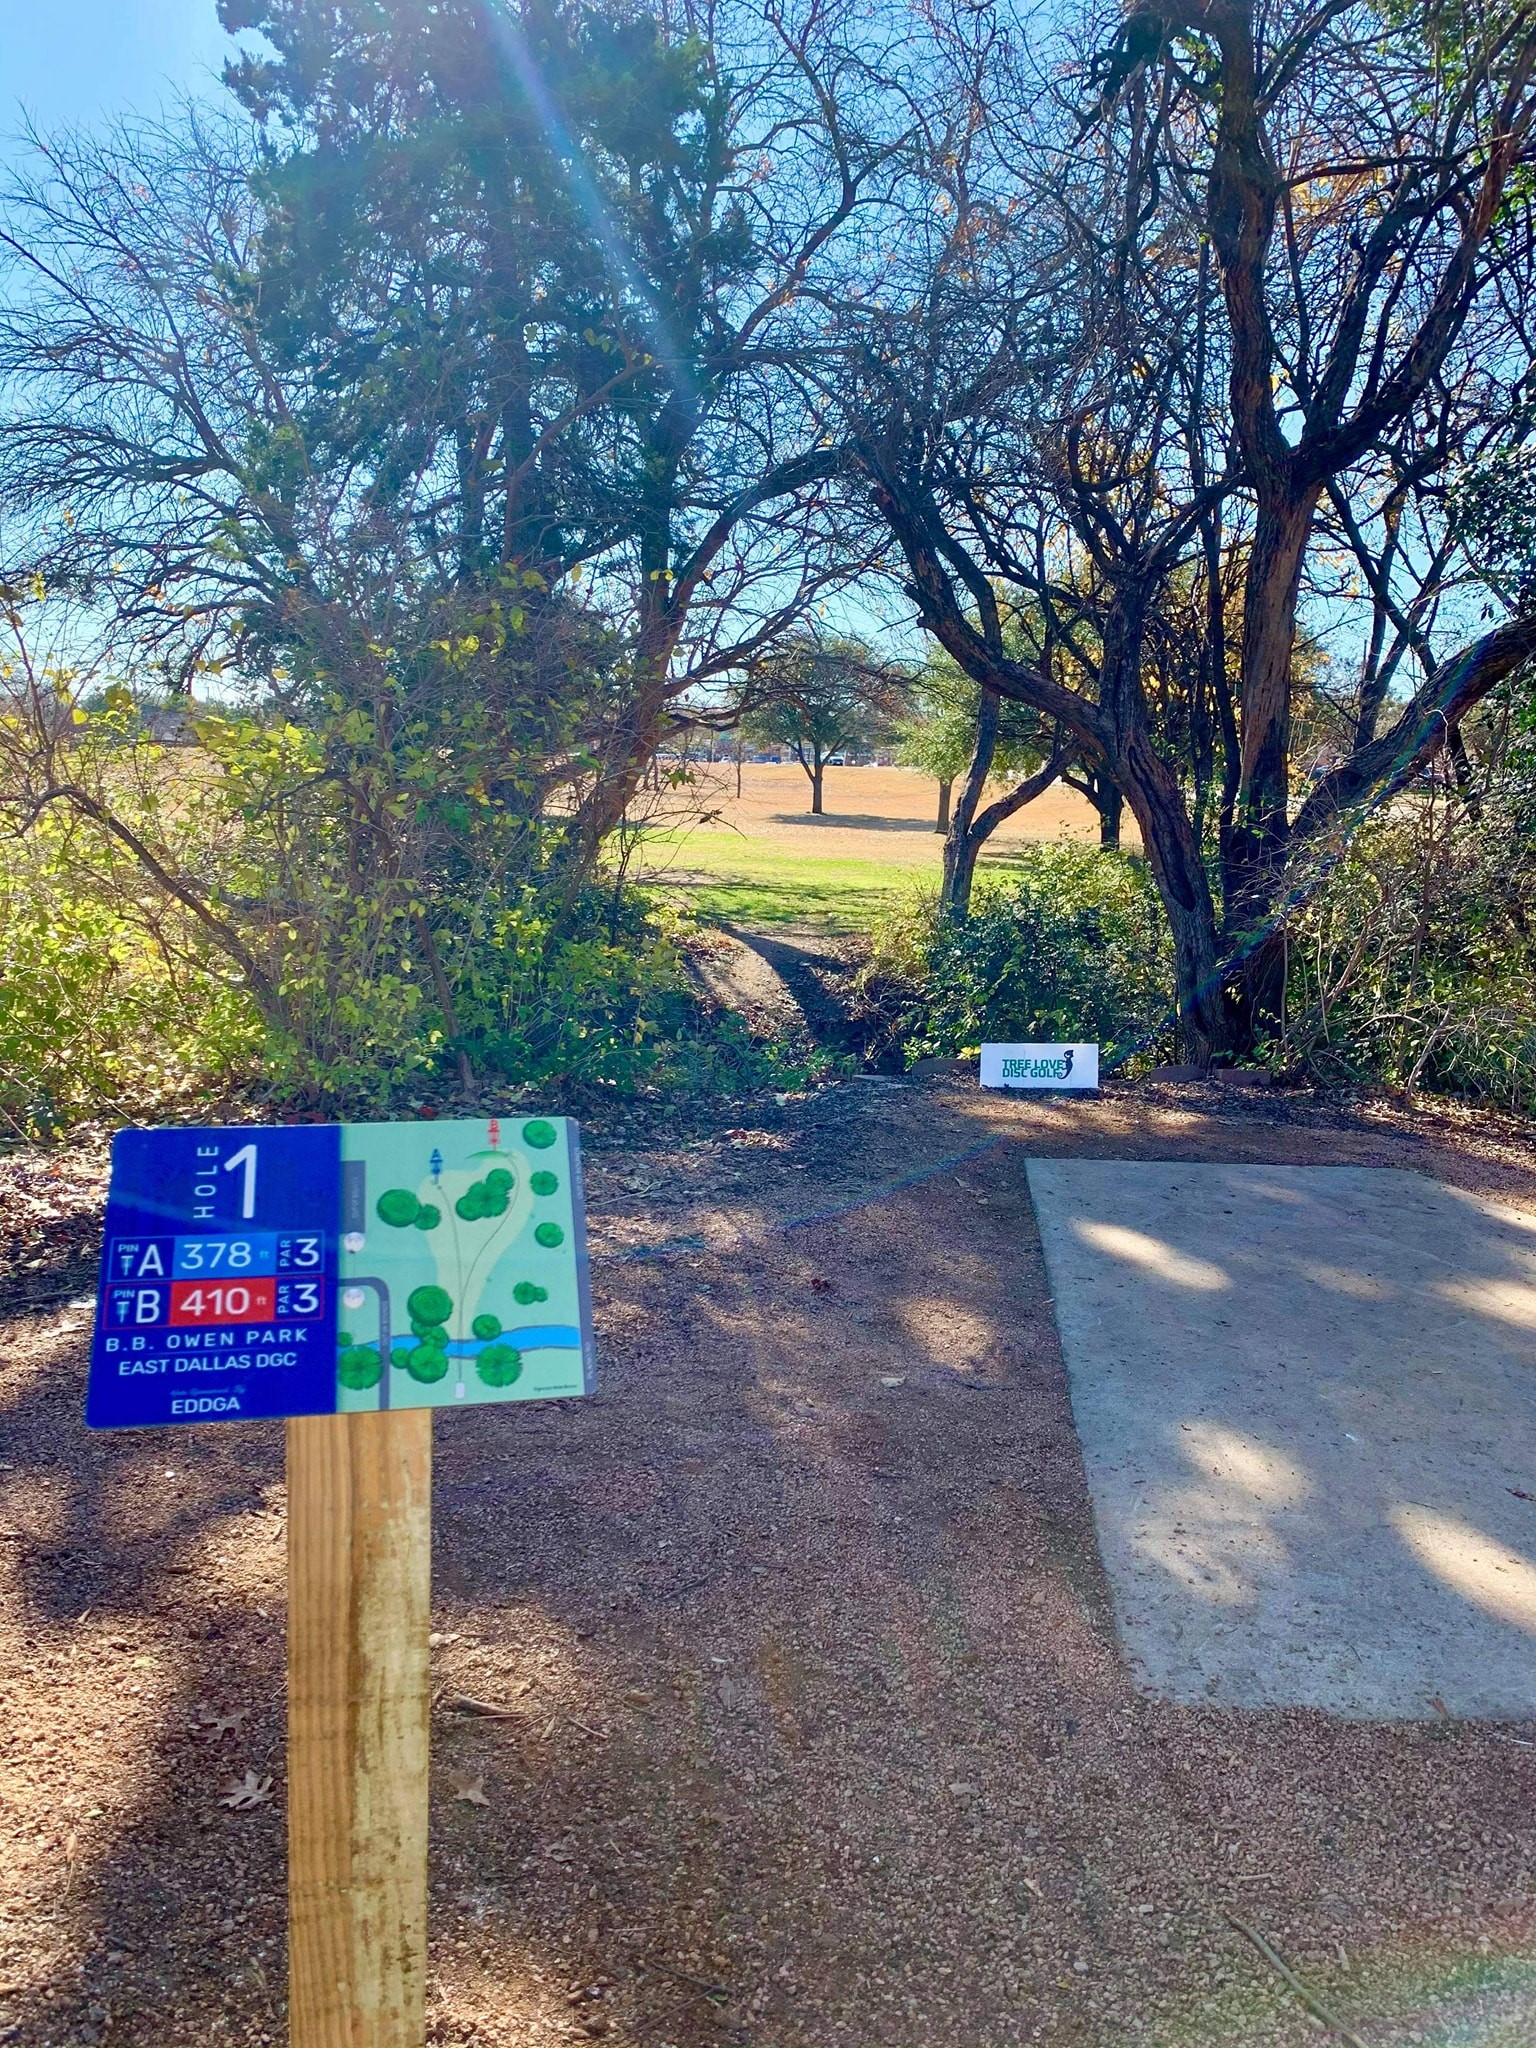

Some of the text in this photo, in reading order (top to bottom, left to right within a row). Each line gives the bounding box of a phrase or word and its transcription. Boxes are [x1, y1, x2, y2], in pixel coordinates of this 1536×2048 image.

[1002, 1059, 1064, 1069] TREE LOVE
[1002, 1068, 1059, 1078] DISC GOLF
[193, 1145, 219, 1218] HOLE
[224, 1144, 257, 1219] 1
[118, 1244, 139, 1253] PIN
[137, 1244, 164, 1277] A
[180, 1242, 269, 1269] 378 ft
[279, 1240, 291, 1267] PAR
[293, 1238, 320, 1267] 3
[114, 1289, 135, 1299] PIN
[136, 1290, 160, 1323] B
[180, 1287, 267, 1316] 410 ft
[278, 1285, 290, 1313] PAR
[292, 1283, 319, 1313] 3
[106, 1328, 308, 1353] B.B. OWEN PARK
[119, 1352, 298, 1376] EAST DALLAS DGC
[171, 1397, 241, 1414] EDDGA
